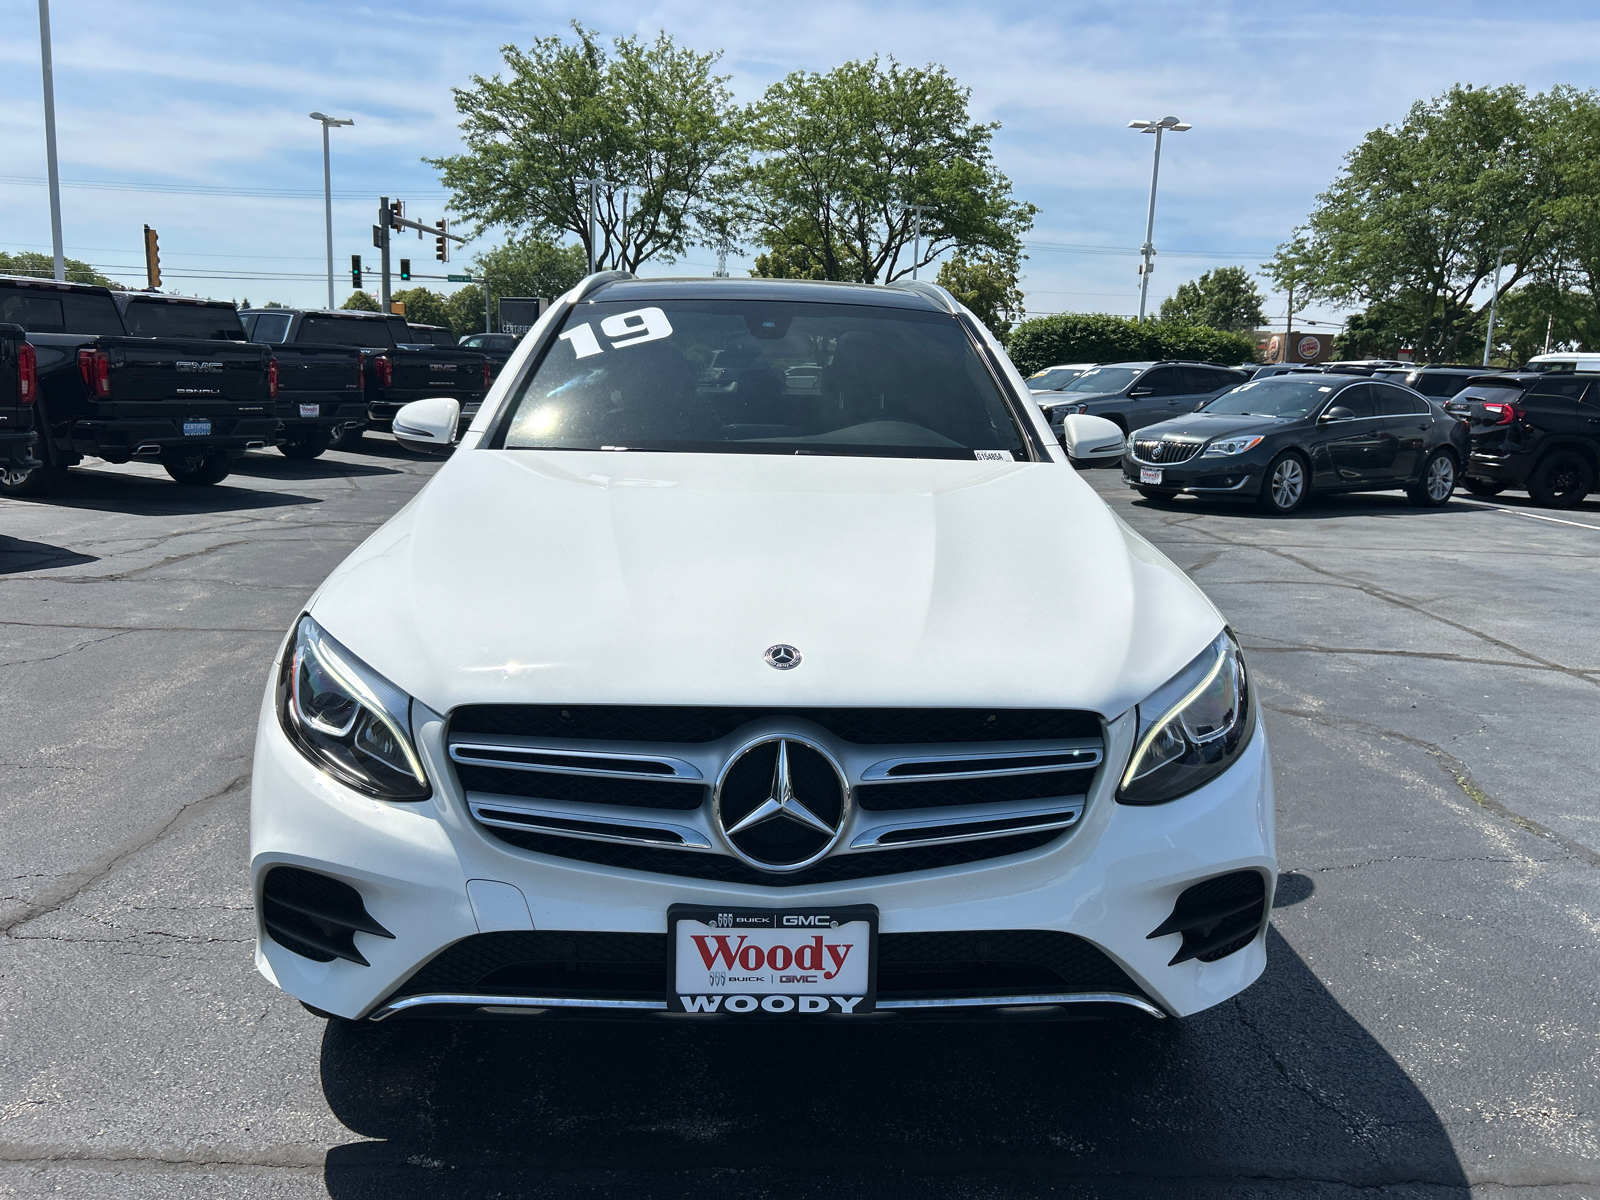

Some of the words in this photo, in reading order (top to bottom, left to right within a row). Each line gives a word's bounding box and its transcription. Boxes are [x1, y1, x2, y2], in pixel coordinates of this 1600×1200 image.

[558, 306, 673, 360] 19
[176, 361, 223, 373] GMC
[429, 364, 458, 372] GMC
[1142, 471, 1160, 480] Woody
[782, 915, 831, 926] GMC
[690, 935, 854, 980] Woody
[779, 975, 818, 983] GMC
[680, 995, 864, 1014] WOODY
